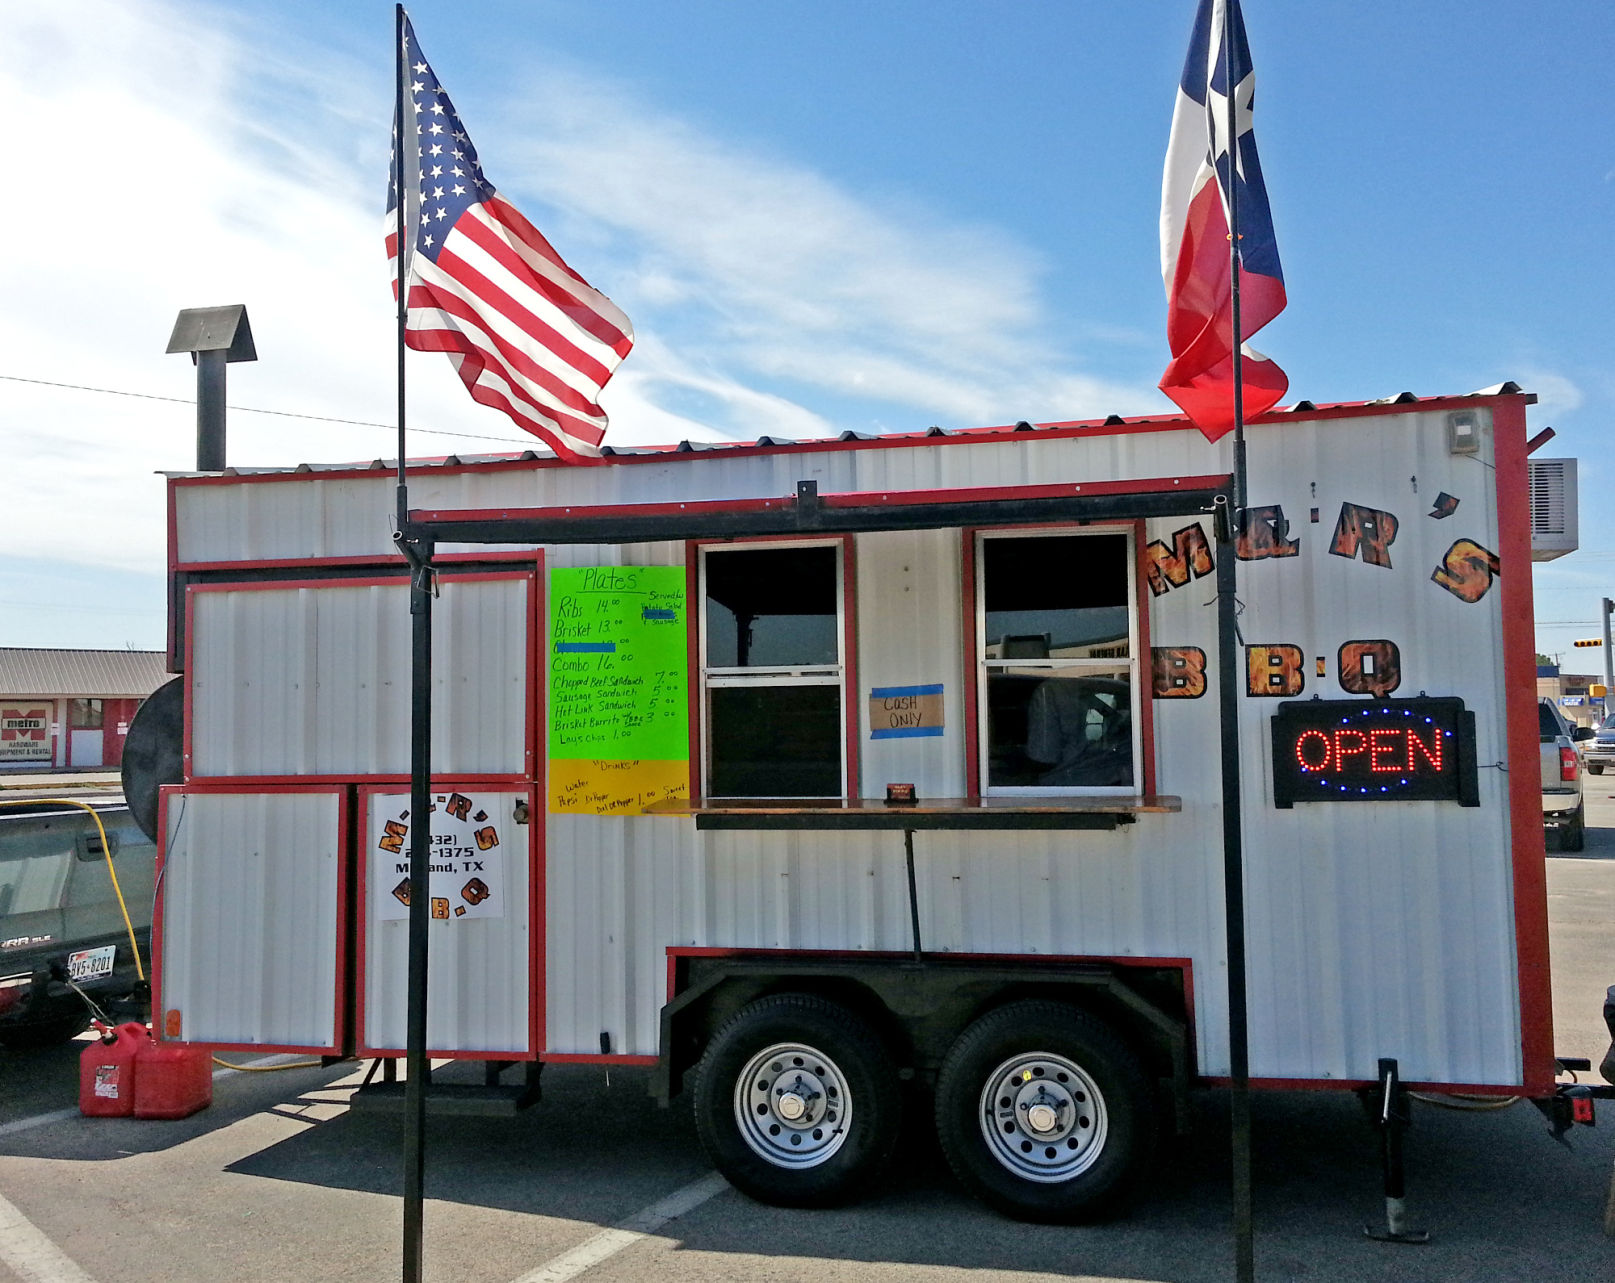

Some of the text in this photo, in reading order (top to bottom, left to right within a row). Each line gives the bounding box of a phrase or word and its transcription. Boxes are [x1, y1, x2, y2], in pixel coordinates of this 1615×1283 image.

[558, 595, 583, 618] Ribs
[554, 619, 592, 638] Brisket
[552, 657, 590, 672] Combo
[597, 688, 637, 699] Sandwich
[599, 700, 637, 712] Sandwich
[7, 719, 40, 728] metro
[554, 718, 587, 731] Brisket
[589, 714, 620, 728] Burrito
[1295, 728, 1443, 773] OPEN
[462, 861, 484, 872] TX
